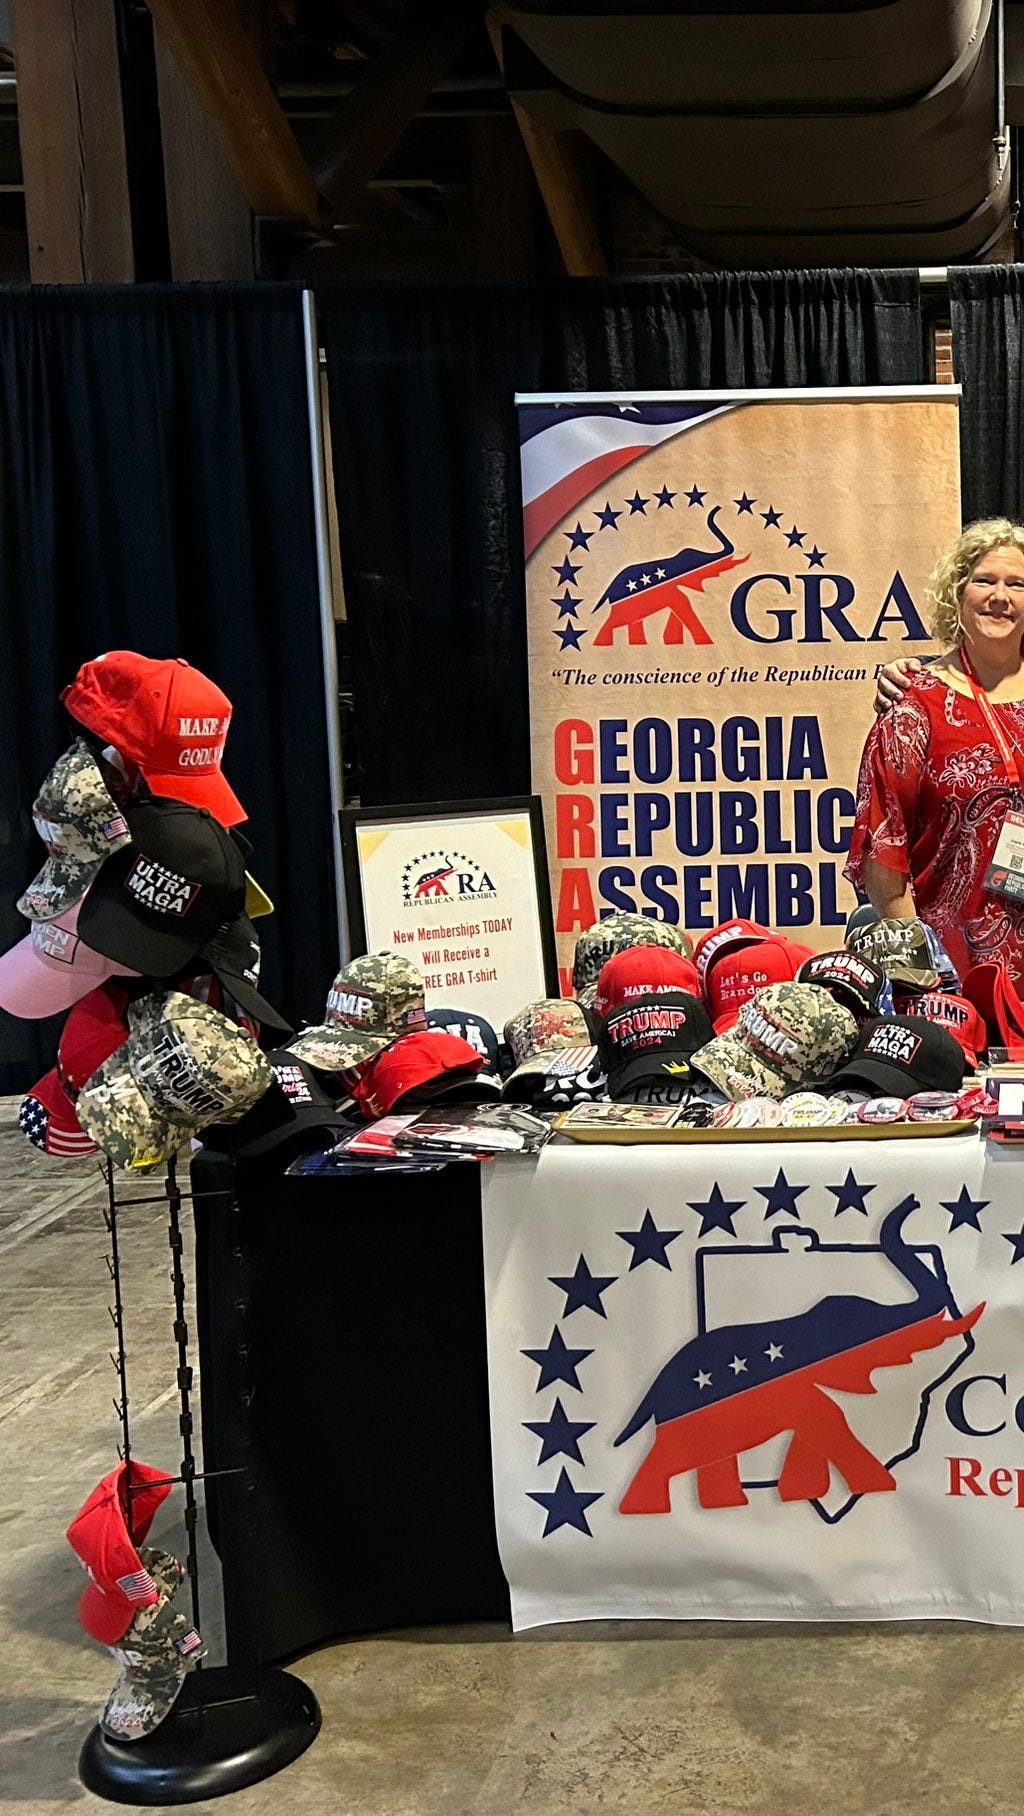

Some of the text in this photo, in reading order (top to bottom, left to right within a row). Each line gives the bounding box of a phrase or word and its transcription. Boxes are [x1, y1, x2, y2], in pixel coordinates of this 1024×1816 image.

[729, 569, 934, 645] GRA
[551, 667, 597, 686] “The
[602, 667, 700, 686] conscience
[707, 666, 728, 687] of
[731, 665, 759, 684] the
[764, 663, 867, 686] Republican
[178, 717, 219, 737] MAKE
[554, 715, 829, 787] GEORGIA
[555, 787, 857, 860] REPUBLIC
[136, 860, 192, 899] ULTRA
[455, 871, 497, 894] RA
[128, 874, 184, 912] MAGA
[403, 891, 498, 908] REPUBLICAN ASSEMBLY
[555, 861, 848, 933] ASSEMBL
[393, 918, 513, 945] New Memberships TODAY
[854, 928, 914, 953] TRUMP
[422, 947, 490, 965] Will Receive a
[421, 968, 498, 989] REE GRA T-shirt
[720, 971, 768, 988] Let's Go
[810, 956, 875, 984] TRUMP
[823, 970, 851, 982] 2024
[326, 989, 373, 1016] UMP
[624, 984, 653, 997] MAKE
[720, 984, 763, 1001] Brando
[903, 997, 969, 1024] TRUMP
[607, 1010, 686, 1044] TRUMP
[621, 1030, 676, 1047] SAVE AMERICA!
[873, 1027, 915, 1048] ULTRA
[632, 1036, 663, 1050] 2024
[867, 1037, 910, 1059] MAGA
[154, 1034, 225, 1116] TRUMP
